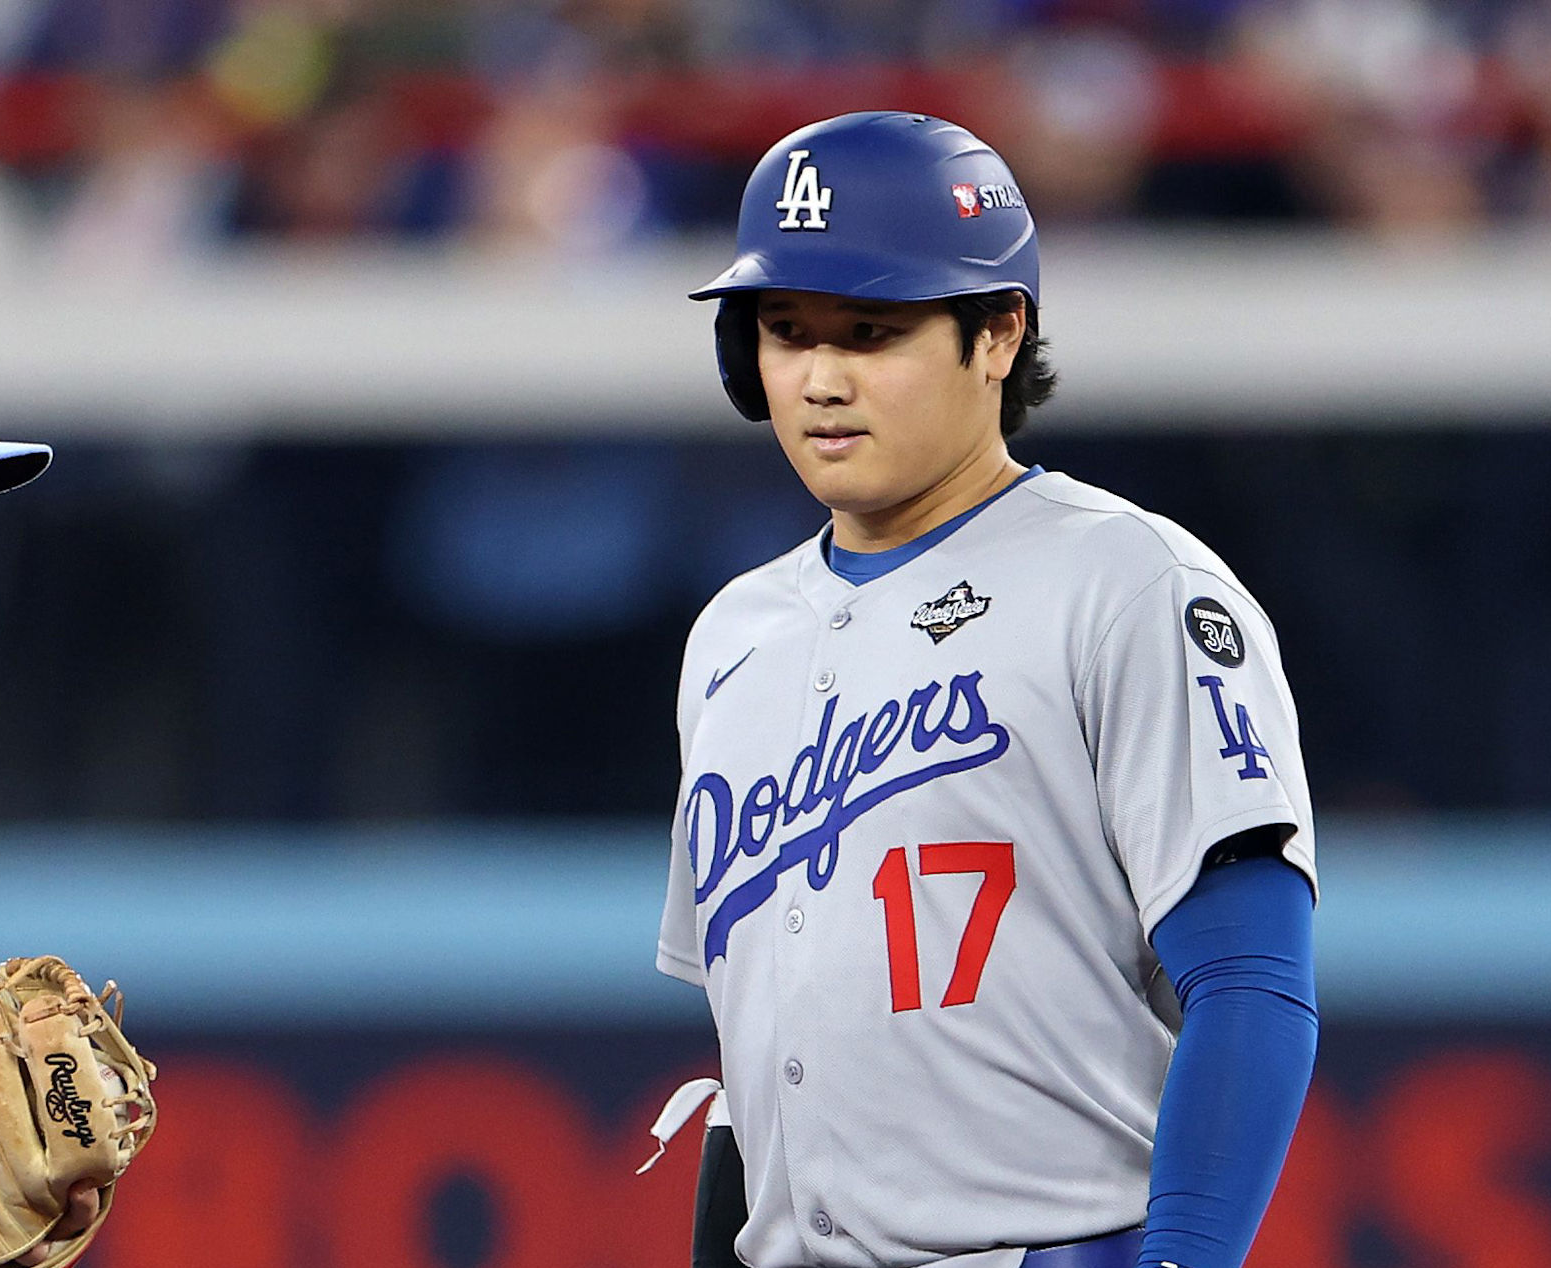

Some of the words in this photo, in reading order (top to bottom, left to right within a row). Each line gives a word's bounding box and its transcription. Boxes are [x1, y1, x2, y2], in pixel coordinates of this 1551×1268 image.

[775, 149, 833, 230] LA
[1199, 620, 1240, 659] 34
[1196, 675, 1269, 780] LA
[684, 671, 1010, 940] Dodgers
[872, 842, 1016, 1014] 17
[45, 1052, 96, 1148] Rawlings
